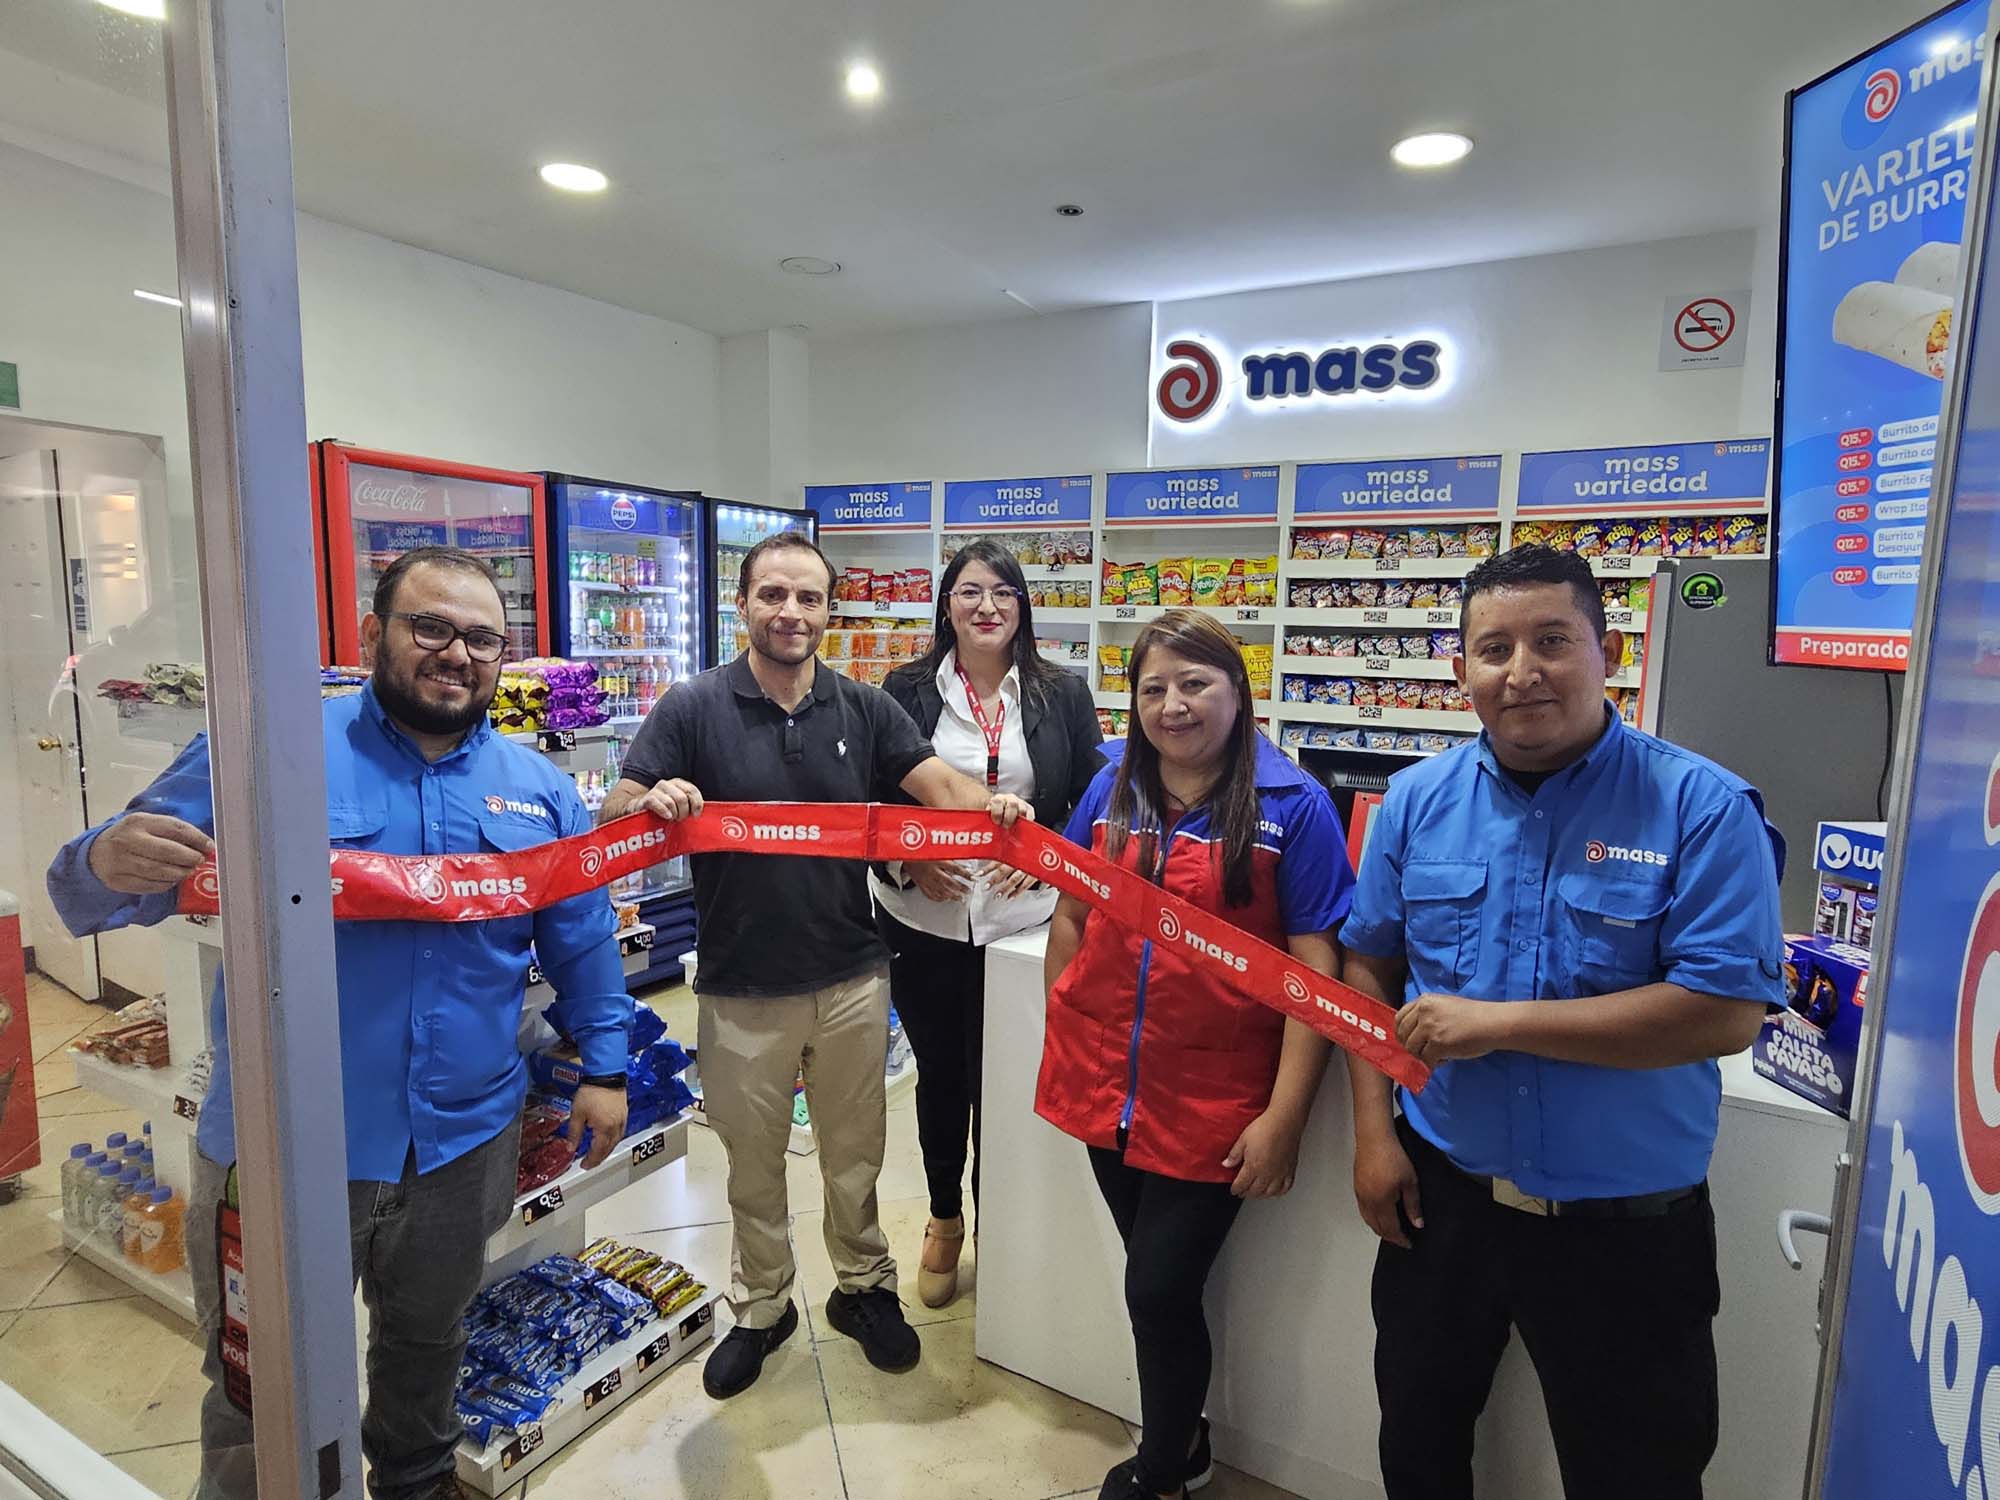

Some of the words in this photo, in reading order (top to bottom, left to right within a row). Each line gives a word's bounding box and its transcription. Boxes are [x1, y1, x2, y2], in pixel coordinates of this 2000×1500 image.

[1818, 209, 1860, 251] DE
[1868, 166, 1971, 233] BURR
[1243, 341, 1441, 400] mass
[1882, 424, 1919, 438] Burrito
[1728, 443, 1765, 454] mass
[1881, 449, 1918, 462] Burrito
[1468, 460, 1498, 469] mass
[1604, 454, 1680, 475] mass
[1252, 470, 1278, 479] mass
[1366, 468, 1429, 485] mass
[1880, 475, 1917, 488] Burrito
[1166, 477, 1219, 493] mass
[1574, 471, 1708, 496] variedad
[849, 491, 889, 504] mass
[996, 487, 1042, 500] mass
[1145, 492, 1239, 510] variedad
[1342, 484, 1453, 505] variedad
[612, 508, 636, 519] PEPSI
[834, 503, 904, 520] variedad
[979, 500, 1060, 518] variedad
[1879, 504, 1908, 515] Wrap
[1800, 637, 1908, 659] Preparado
[504, 801, 547, 818] mass
[752, 824, 822, 841] mass
[1255, 820, 1284, 837] ass
[604, 827, 666, 861] mass
[930, 829, 994, 846] mass
[1607, 846, 1668, 866] mass
[450, 875, 528, 897] mass
[1062, 859, 1112, 900] mass
[1184, 928, 1249, 974] mass
[1315, 994, 1388, 1042] mass
[1772, 1029, 1835, 1073] PALETA
[1766, 1041, 1843, 1095] PAYASO
